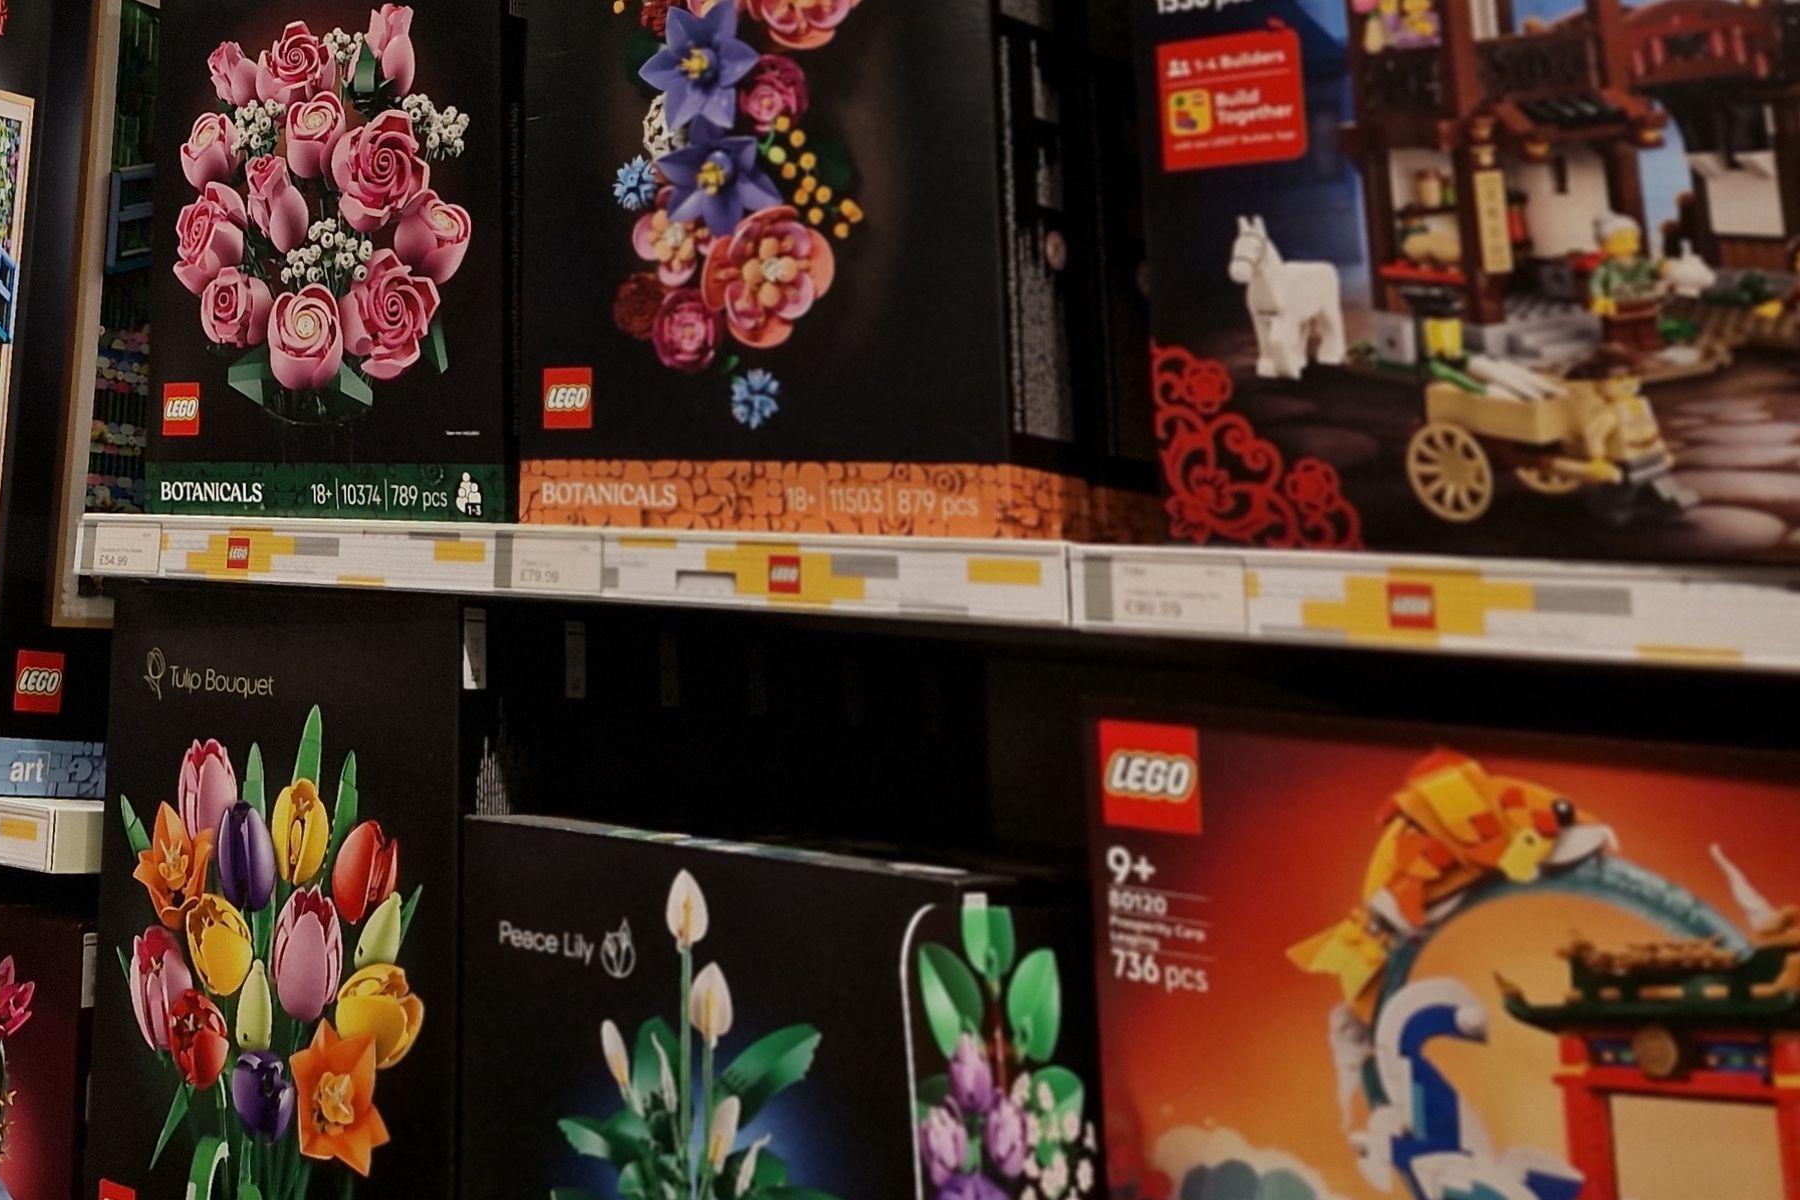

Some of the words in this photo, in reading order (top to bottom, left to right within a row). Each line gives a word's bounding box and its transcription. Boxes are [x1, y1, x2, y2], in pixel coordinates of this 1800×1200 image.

[1219, 50, 1286, 69] Builders
[1214, 89, 1261, 107] Build
[1216, 104, 1294, 126] Together
[164, 397, 199, 420] LEGO
[545, 384, 591, 411] LEGO
[161, 482, 263, 503] BOTANICALS
[310, 484, 332, 504] 18+
[342, 485, 381, 505] 10374
[391, 485, 418, 506] 789
[423, 490, 447, 511] pcs
[467, 505, 481, 516] 1-3
[541, 483, 677, 508] BOTANICALS
[787, 487, 816, 511] 18+
[830, 489, 884, 513] 11503
[898, 489, 936, 513] 879
[942, 497, 979, 519] pcs
[100, 554, 128, 566] £54.99
[17, 667, 62, 695] LEGO
[169, 665, 201, 694] Tulip
[205, 668, 275, 699] Bouquet
[10, 757, 44, 782] art
[1105, 750, 1196, 801] LEGO
[1106, 846, 1156, 884] 9+
[1108, 888, 1168, 916] 80120
[499, 920, 559, 954] Peace
[563, 931, 594, 966] Lily
[1112, 948, 1161, 984] 736
[1164, 966, 1209, 993] pcs
